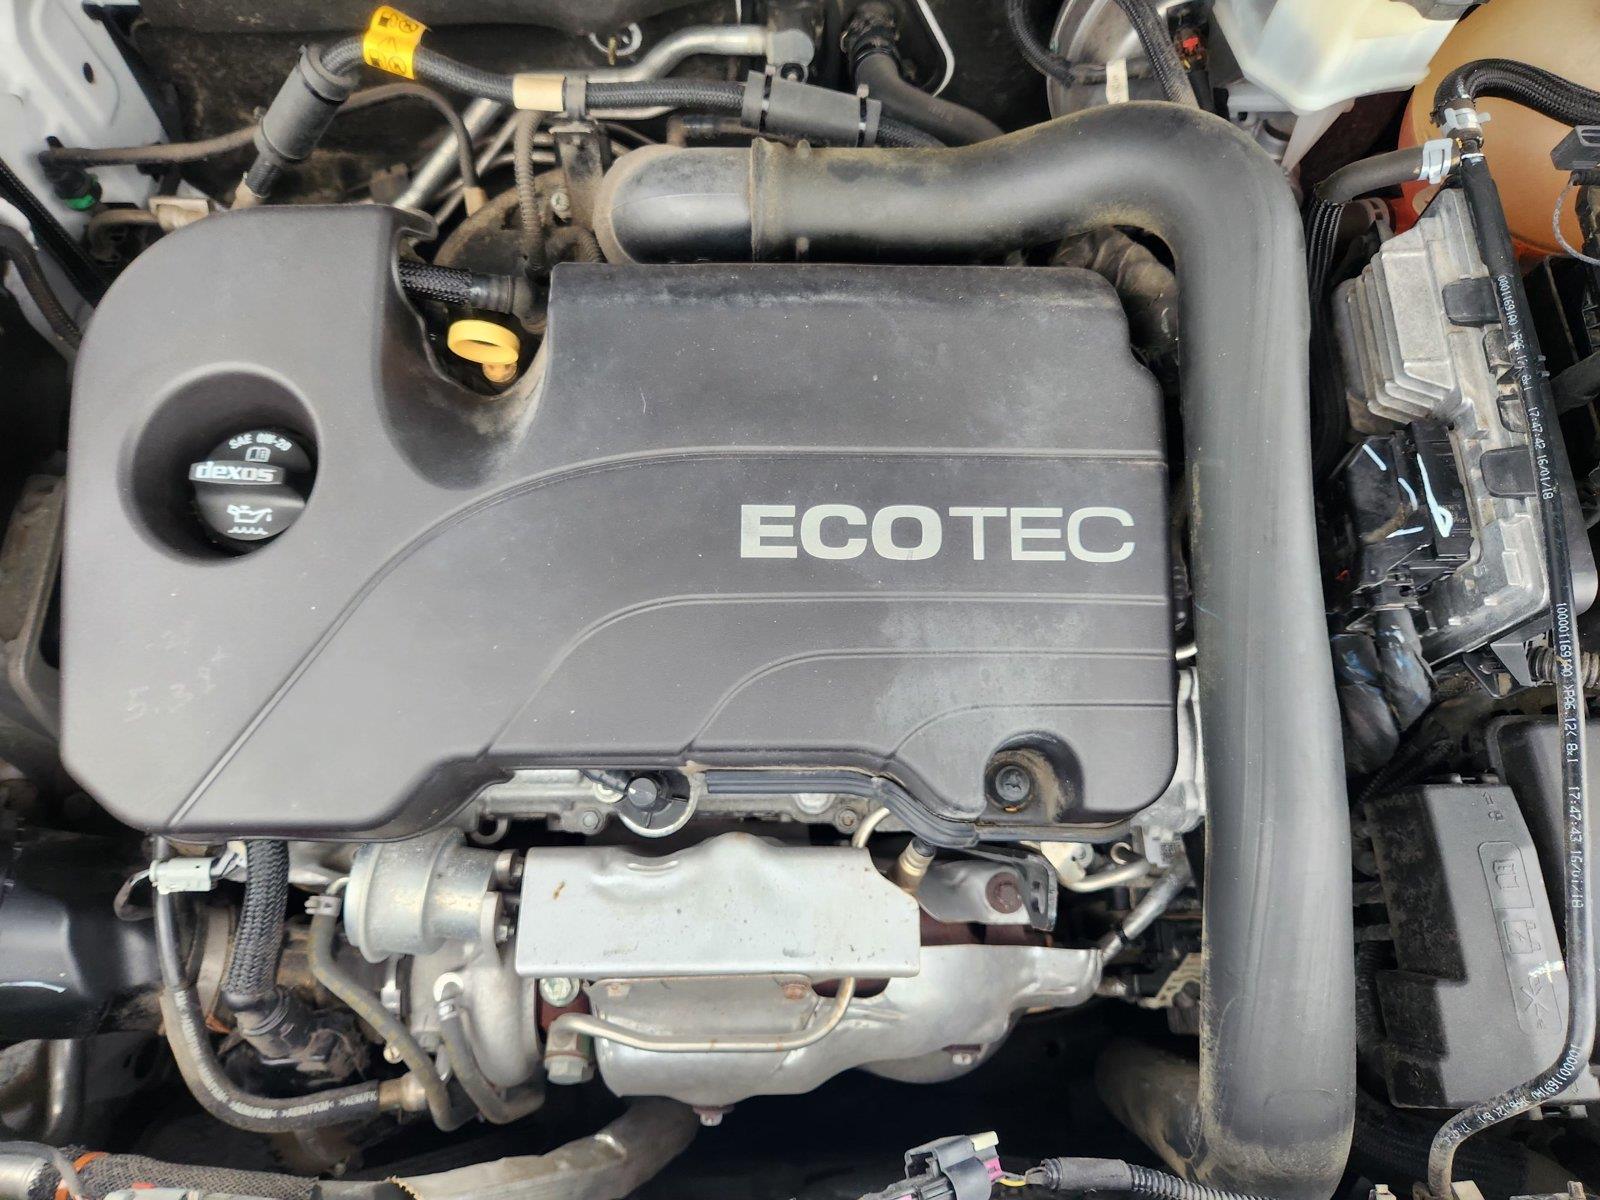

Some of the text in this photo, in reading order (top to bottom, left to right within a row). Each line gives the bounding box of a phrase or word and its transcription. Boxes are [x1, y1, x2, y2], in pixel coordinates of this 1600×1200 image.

[228, 432, 253, 449] SAE
[195, 461, 277, 483] dexos
[1537, 454, 1554, 500] 16/01/18
[740, 504, 1136, 563] ECOTEC
